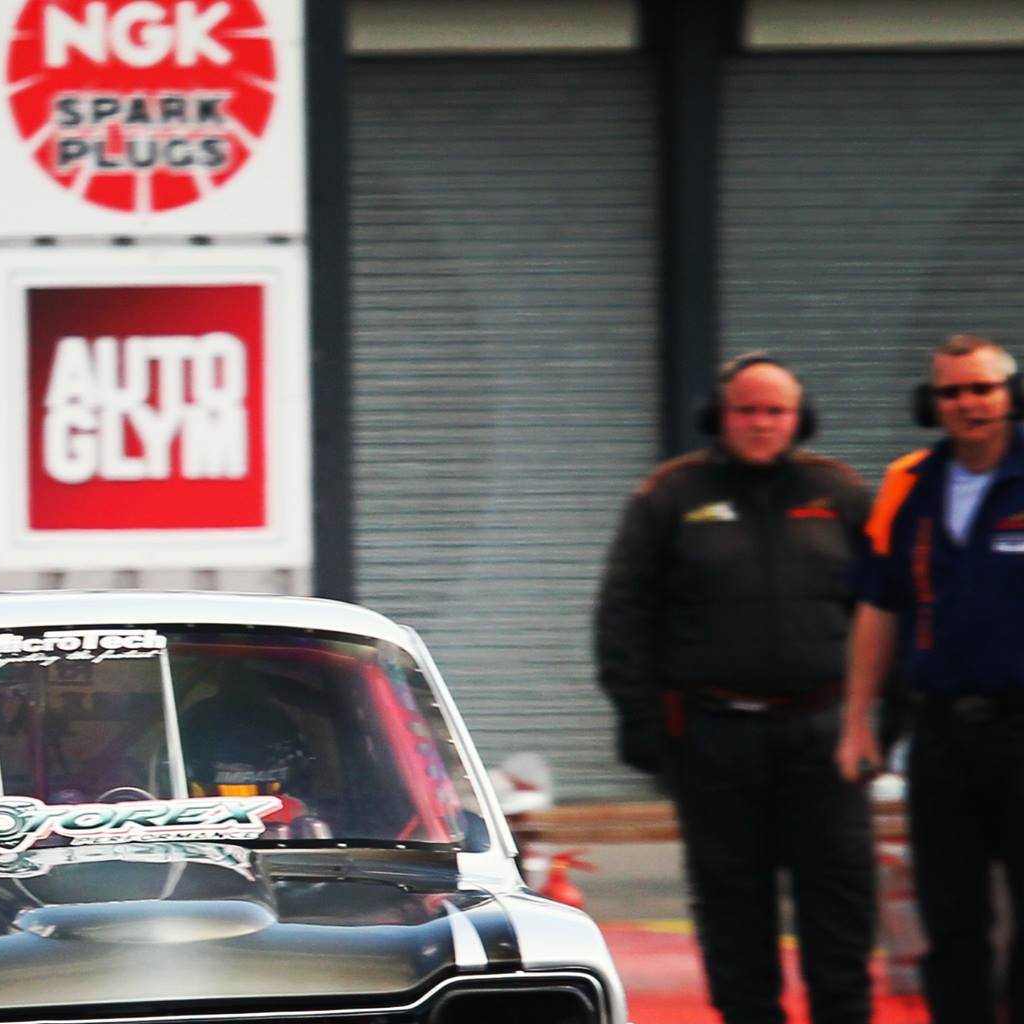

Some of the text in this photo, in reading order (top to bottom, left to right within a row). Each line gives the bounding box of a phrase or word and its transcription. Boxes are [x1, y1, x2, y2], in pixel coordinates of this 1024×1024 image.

[44, 0, 233, 68] NGK
[55, 96, 225, 126] SPARK
[56, 138, 228, 168] PLUGS
[45, 332, 248, 404] AUTO
[43, 403, 249, 484] GLYM
